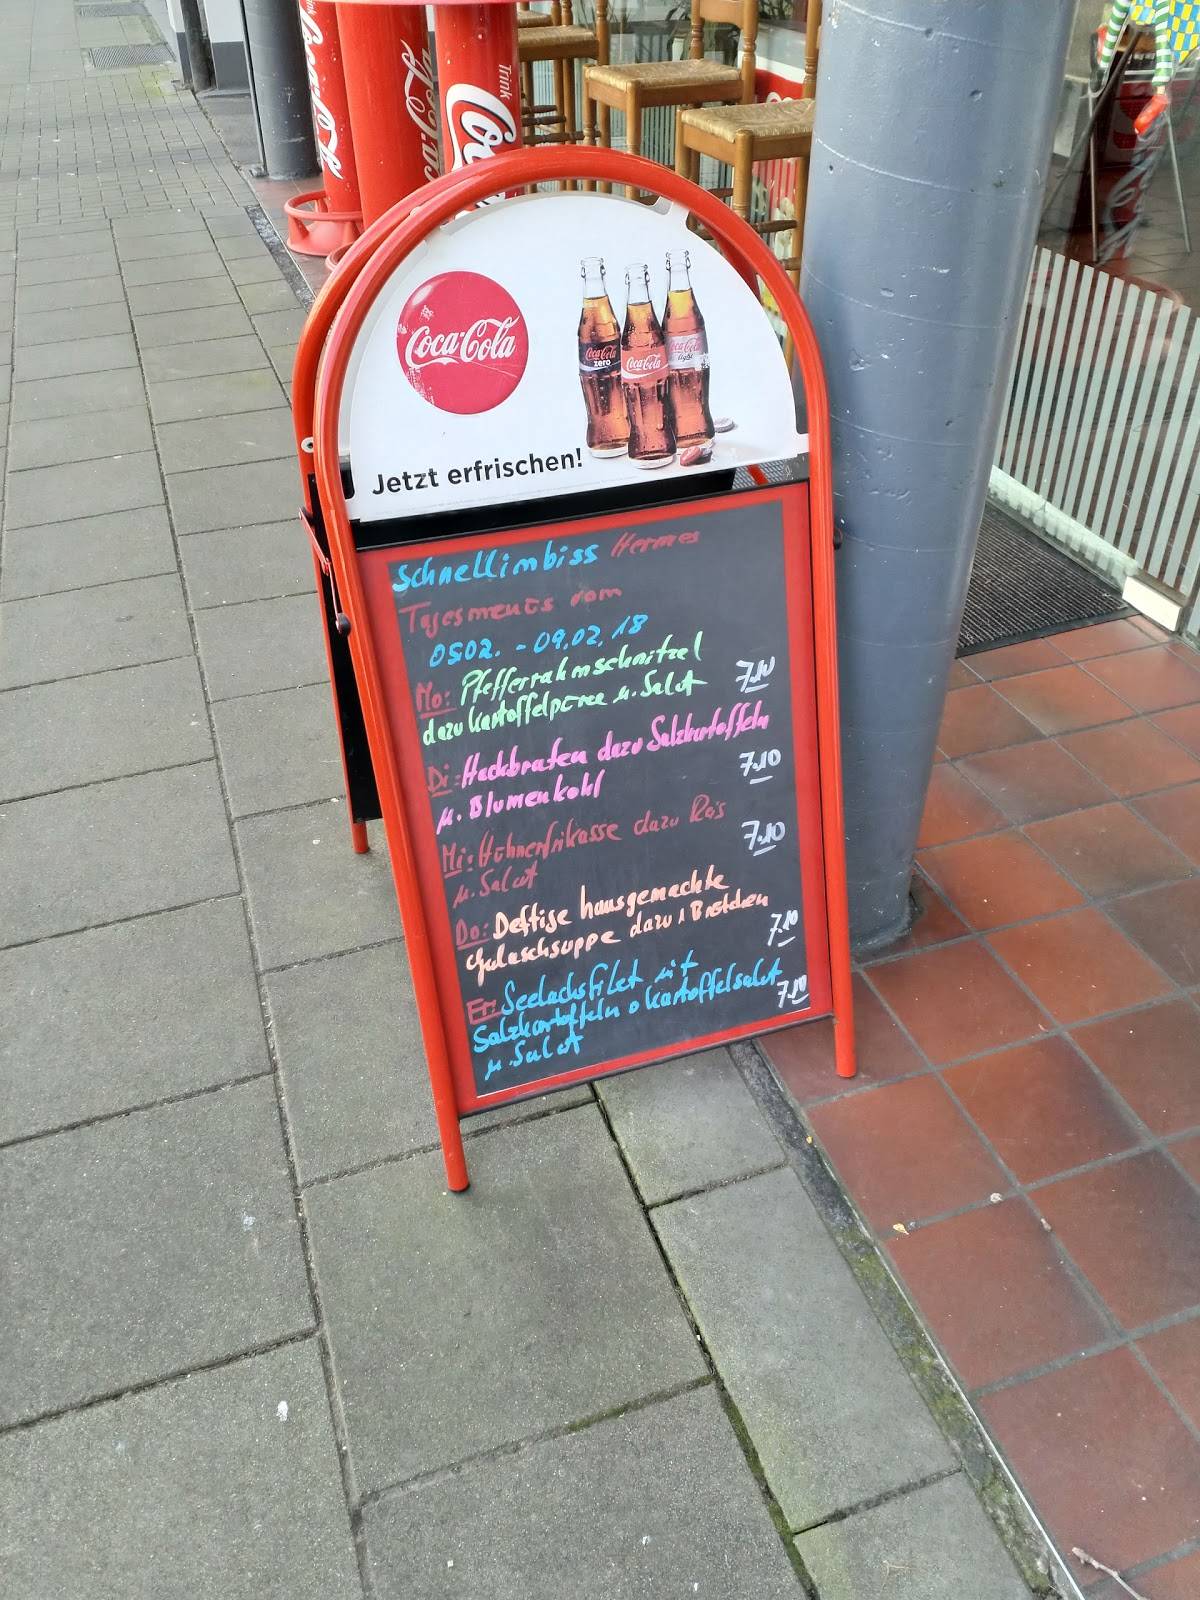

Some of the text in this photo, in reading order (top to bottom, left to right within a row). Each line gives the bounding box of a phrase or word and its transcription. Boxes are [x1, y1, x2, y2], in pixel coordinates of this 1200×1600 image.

[498, 64, 512, 100] Trink
[404, 315, 520, 368] Coca-Cola
[585, 345, 617, 361] Coca-Cola
[594, 359, 611, 367] zero
[626, 354, 660, 372] Coca-Cola
[372, 467, 439, 495] Jetzt
[447, 448, 583, 485] erfrischen!
[392, 531, 700, 592] Schnellimbiss Hermes
[423, 718, 463, 745] dazu
[640, 669, 708, 697] Salat
[598, 730, 643, 761] dazu
[739, 749, 782, 779] 7.10
[469, 769, 606, 820] Blumenkohl
[633, 809, 680, 836] dazu
[742, 820, 786, 852] 7.10
[629, 911, 673, 938] dazu
